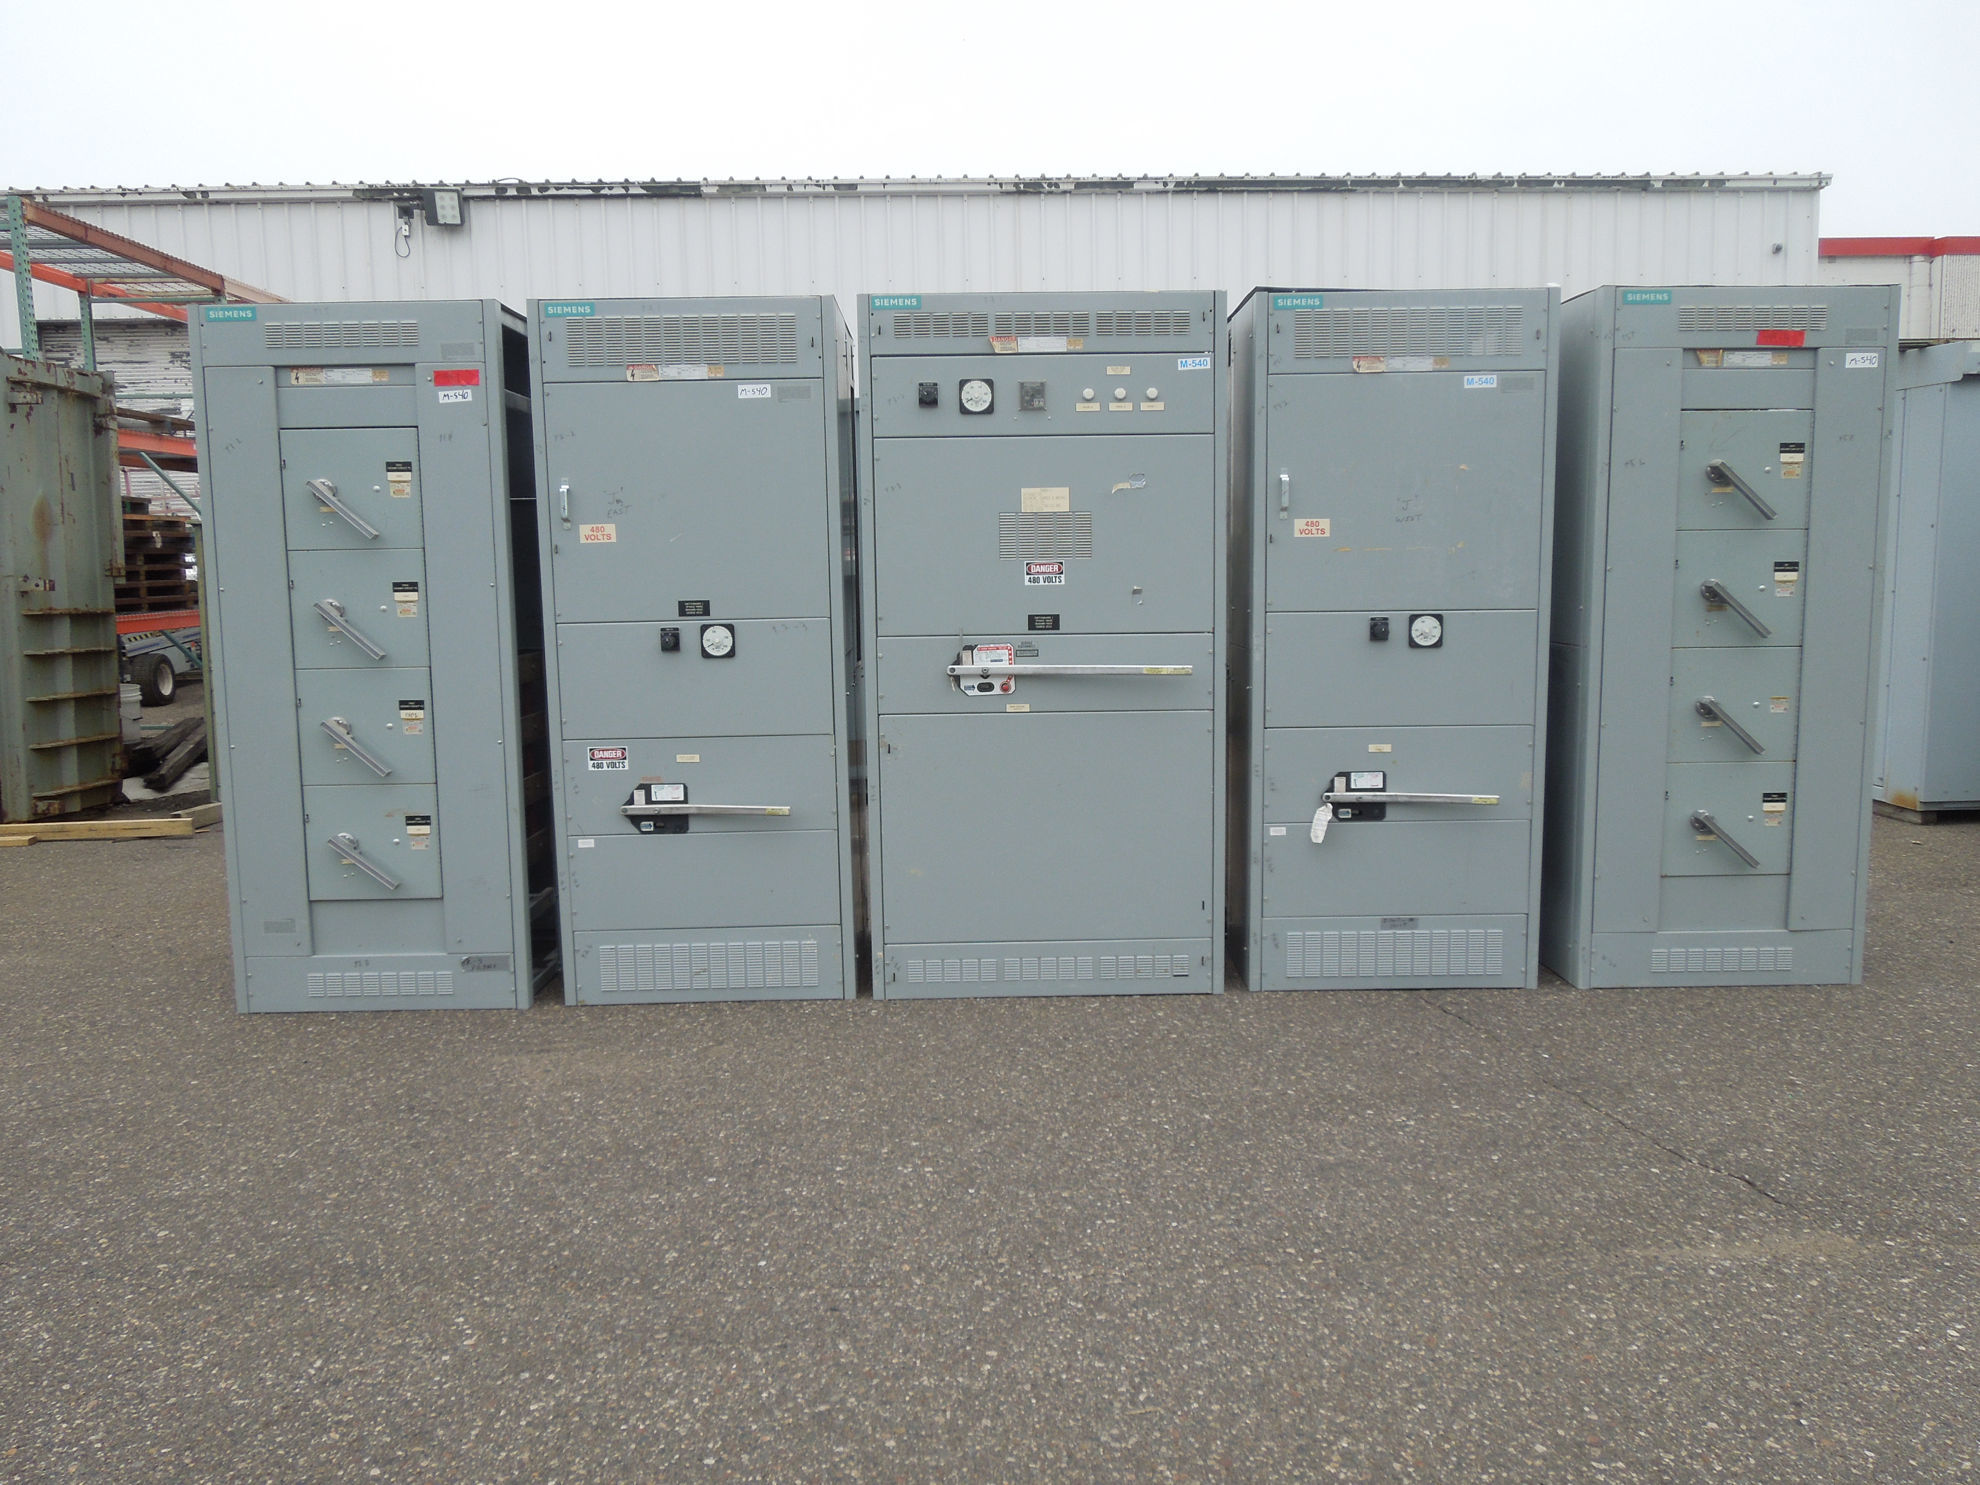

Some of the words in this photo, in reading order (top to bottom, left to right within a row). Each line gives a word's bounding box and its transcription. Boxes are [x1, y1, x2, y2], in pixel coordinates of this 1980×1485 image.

[1627, 293, 1669, 301] SIEMENS
[874, 298, 917, 306] SIEMENS
[1277, 298, 1320, 306] SIEMENS
[209, 310, 252, 318] SIEMENS
[547, 305, 591, 314] SIEMENS
[1180, 359, 1208, 369] M-540
[1467, 376, 1495, 385] M-540
[443, 391, 469, 400] M-540
[740, 386, 768, 396] M-540
[1305, 520, 1320, 528] 480
[584, 533, 612, 541] VOLTS
[1031, 563, 1059, 573] DANGER
[1027, 575, 1040, 584] 480
[1043, 575, 1063, 584] VOLTS
[594, 749, 622, 758] DANGER
[592, 761, 604, 770] 480
[606, 760, 626, 769] VOLTS
